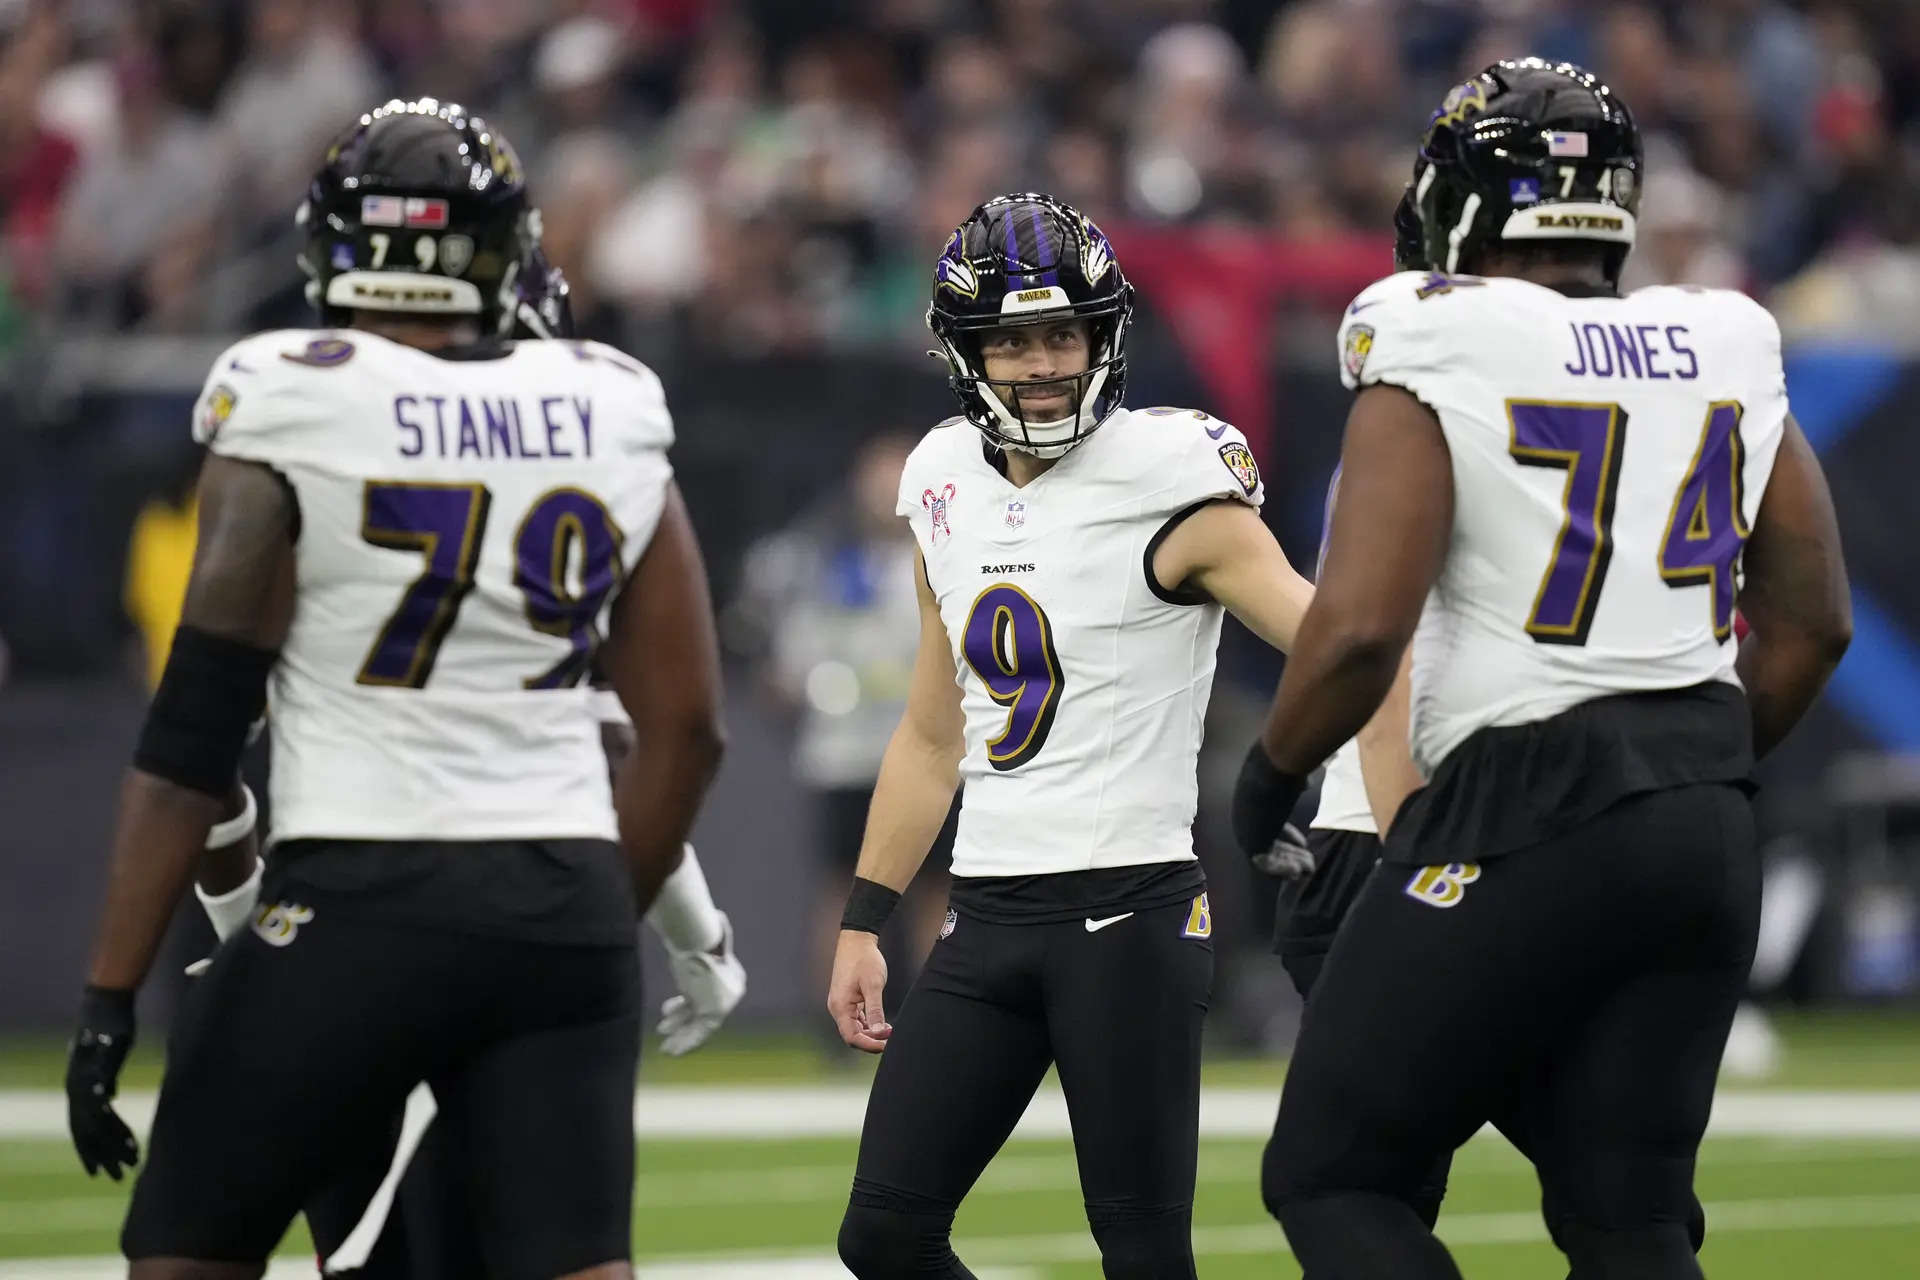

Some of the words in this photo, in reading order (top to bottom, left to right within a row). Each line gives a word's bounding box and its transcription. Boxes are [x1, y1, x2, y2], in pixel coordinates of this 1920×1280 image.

[1016, 289, 1052, 303] RAVENS
[1566, 321, 1699, 381] JONES
[393, 397, 592, 459] STANLEY
[1503, 397, 1750, 647] 74
[356, 479, 625, 690] 79
[981, 563, 1036, 574] RAVENS
[960, 582, 1066, 772] 9
